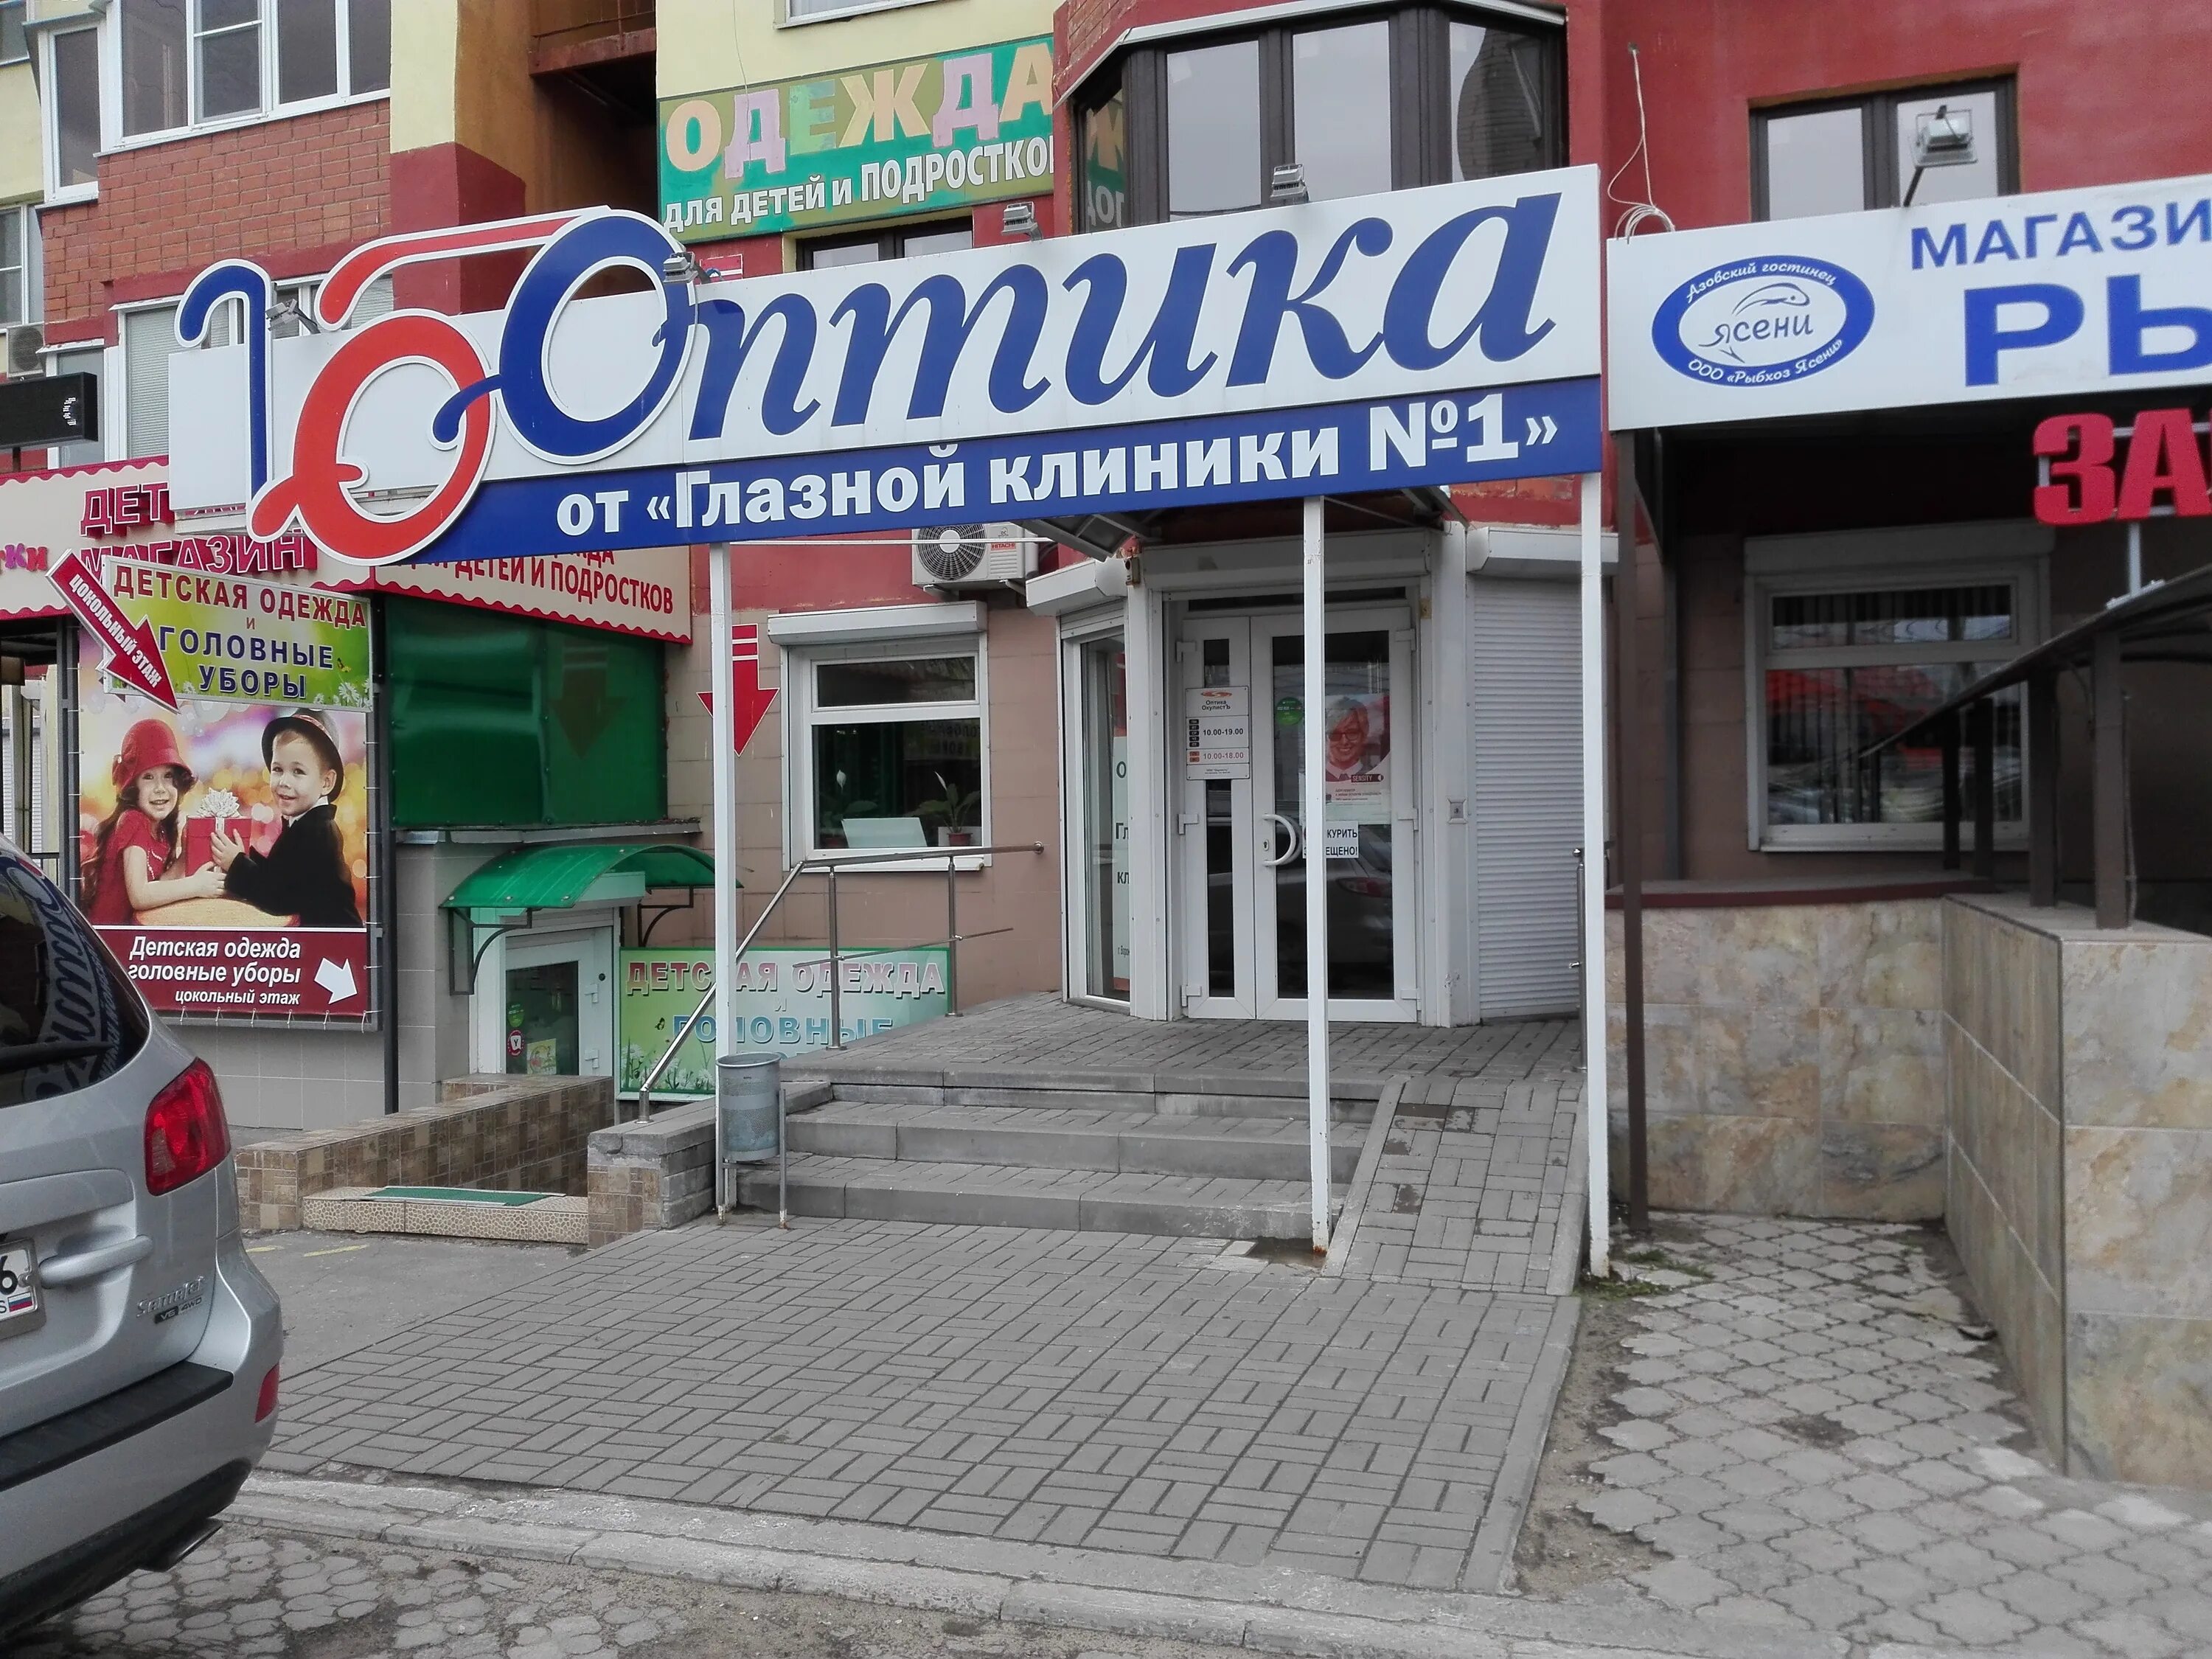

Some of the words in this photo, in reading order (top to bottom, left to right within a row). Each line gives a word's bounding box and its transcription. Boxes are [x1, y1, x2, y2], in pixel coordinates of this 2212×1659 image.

[666, 42, 1053, 179] ОДЕЖДА
[665, 196, 723, 234] ДЛЯ
[731, 175, 827, 226] ДЕТЕЙ
[860, 136, 1053, 204] ПОДРОСТКО
[1686, 262, 1757, 304] Азовский
[1761, 262, 1838, 286] гостинец
[499, 204, 1557, 456] Оптика
[1688, 358, 1724, 380] ООО
[557, 490, 629, 536] от
[646, 445, 966, 529] «Глазной
[989, 426, 1340, 504] клиники
[1369, 393, 1559, 473] №1»
[2034, 407, 2212, 526] ЗА
[114, 565, 248, 611] ДЕТСКАЯ
[260, 588, 366, 630] ОДЕЖДА
[551, 560, 674, 614] ПОДРОСТКОВ
[69, 574, 138, 655] ЦОКОЛЬНЫЙ
[131, 650, 162, 688] ЭТАЖ
[159, 625, 334, 669] ГОЛОВНЫЕ
[199, 665, 307, 699] УБОРЫ
[1203, 728, 1244, 736] 10.00-19.00
[1326, 829, 1358, 839] КУРИТЬ
[129, 936, 219, 961] Детская
[224, 936, 302, 959] одежда
[128, 964, 227, 981] головные
[231, 961, 302, 987] уборы
[627, 961, 779, 995] ДЕТСАЯ
[796, 962, 945, 998] ОДЕЖДА
[175, 989, 256, 1004] цокольный
[259, 991, 301, 1005] этаж
